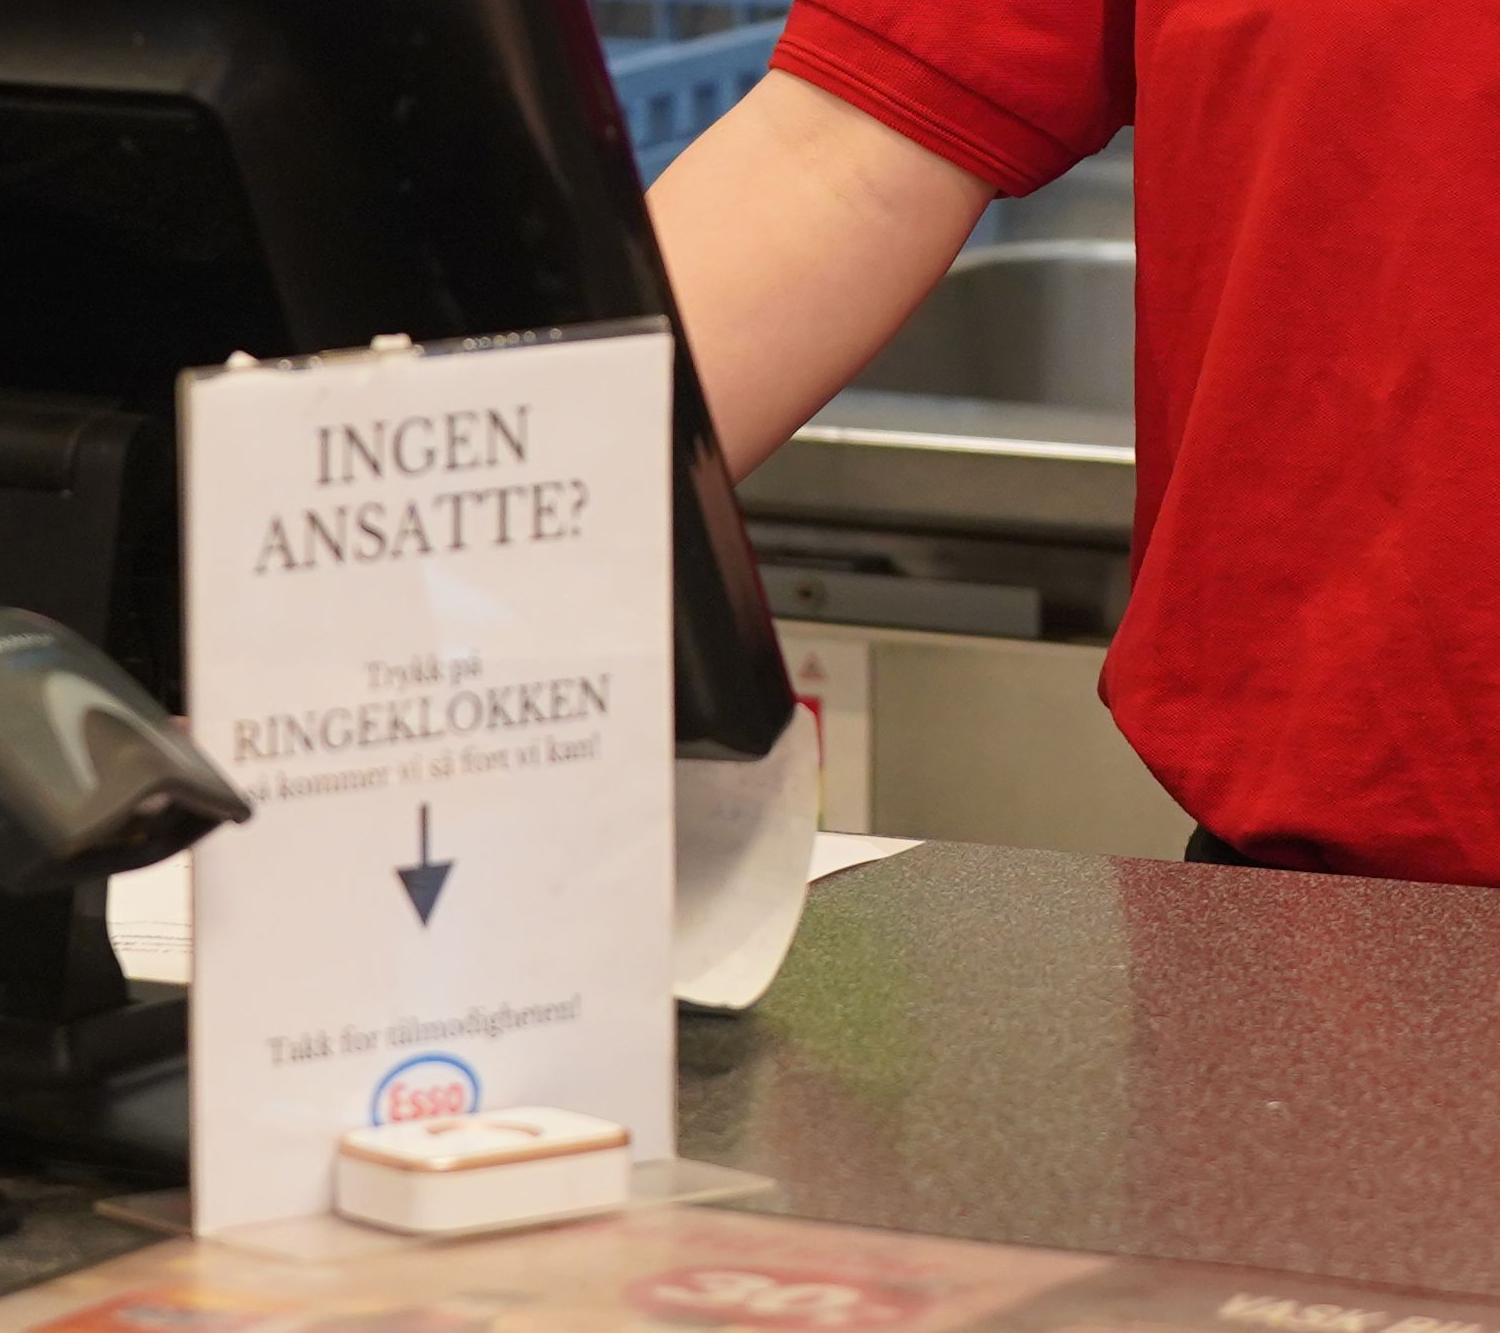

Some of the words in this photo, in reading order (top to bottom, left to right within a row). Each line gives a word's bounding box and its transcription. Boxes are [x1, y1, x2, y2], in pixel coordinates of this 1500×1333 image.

[315, 405, 532, 486] INGEN
[253, 478, 590, 576] ANSATTE?
[232, 674, 613, 765] RINGEKLOKKEN
[388, 1082, 465, 1123] Esso
